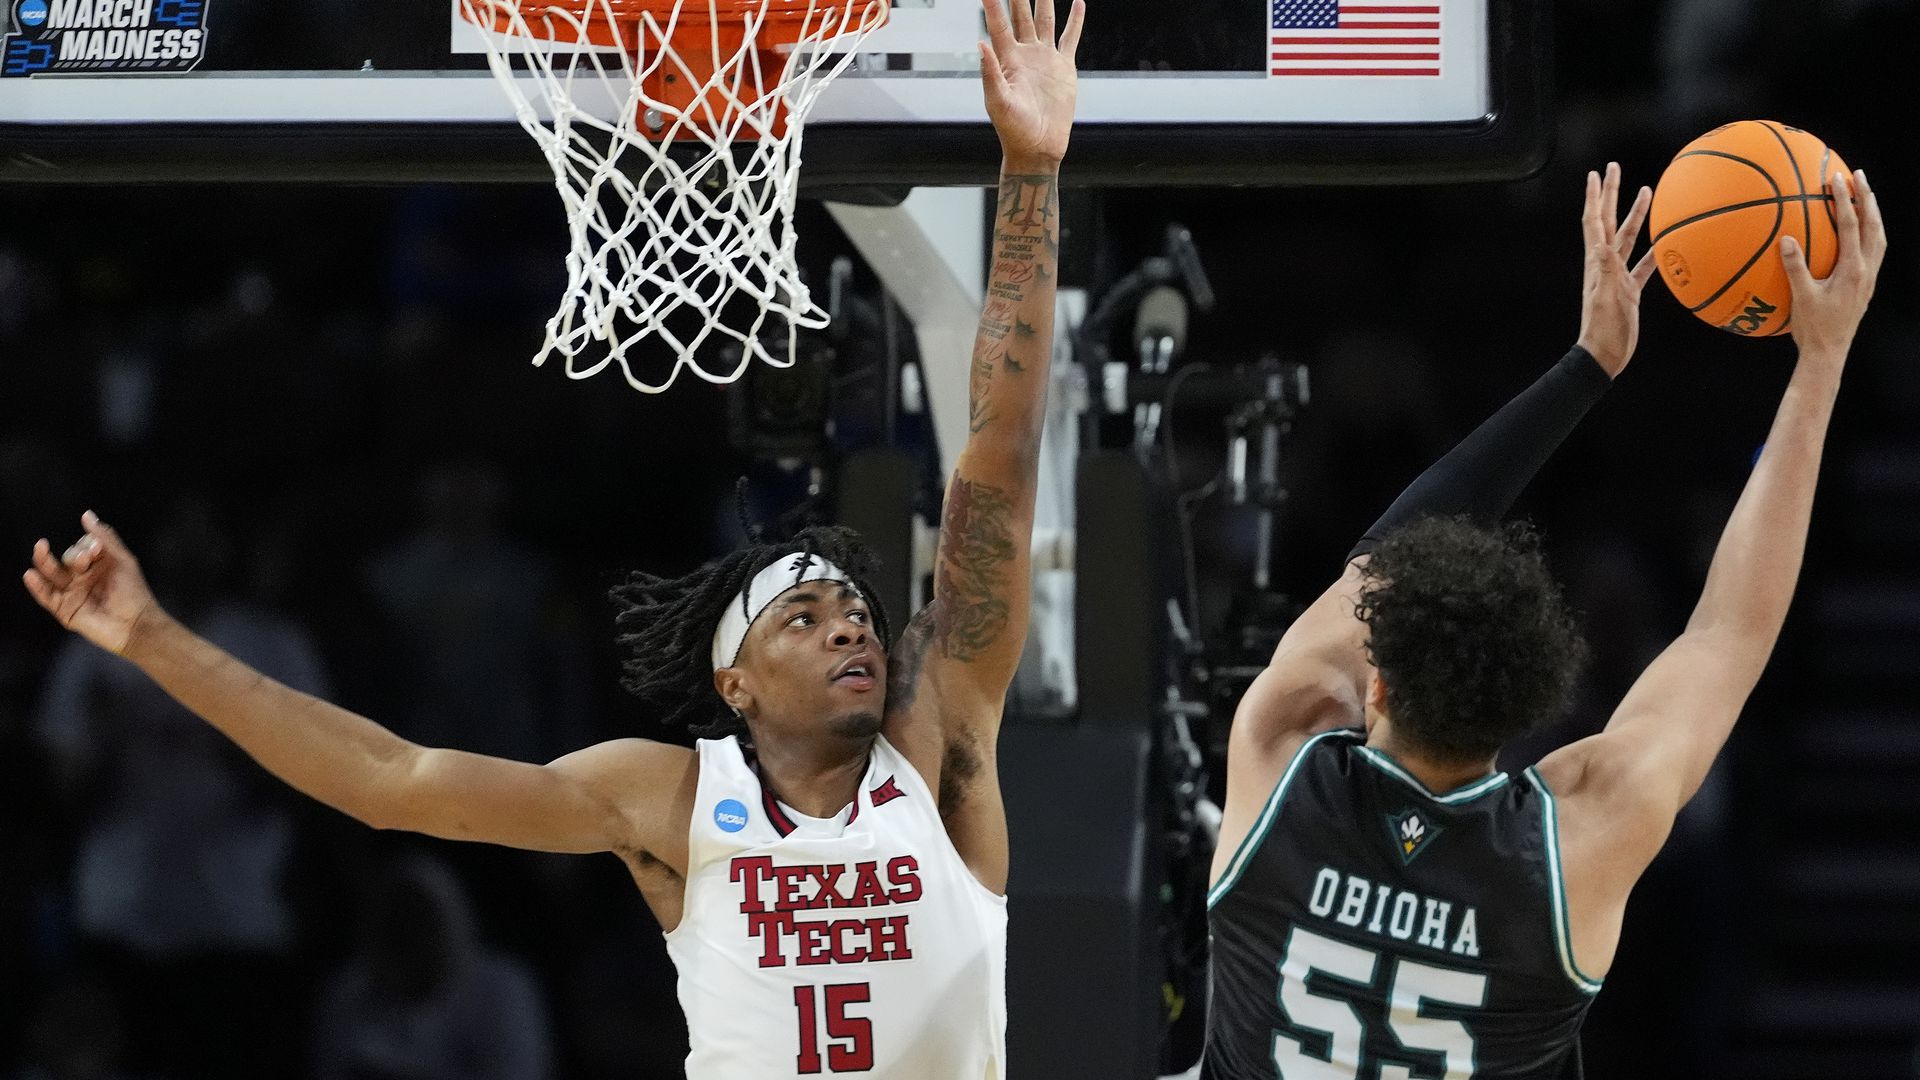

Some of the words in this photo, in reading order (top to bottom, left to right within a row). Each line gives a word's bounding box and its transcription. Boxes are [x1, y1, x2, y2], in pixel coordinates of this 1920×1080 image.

[47, 0, 154, 28] MARCH
[59, 29, 200, 61] MADNESS
[717, 812, 747, 826] NCAA
[729, 855, 923, 913] TEXAS
[1308, 866, 1480, 957] OBIOHA
[747, 911, 913, 968] TECH
[793, 982, 874, 1075] 15
[1272, 922, 1489, 1080] 55
